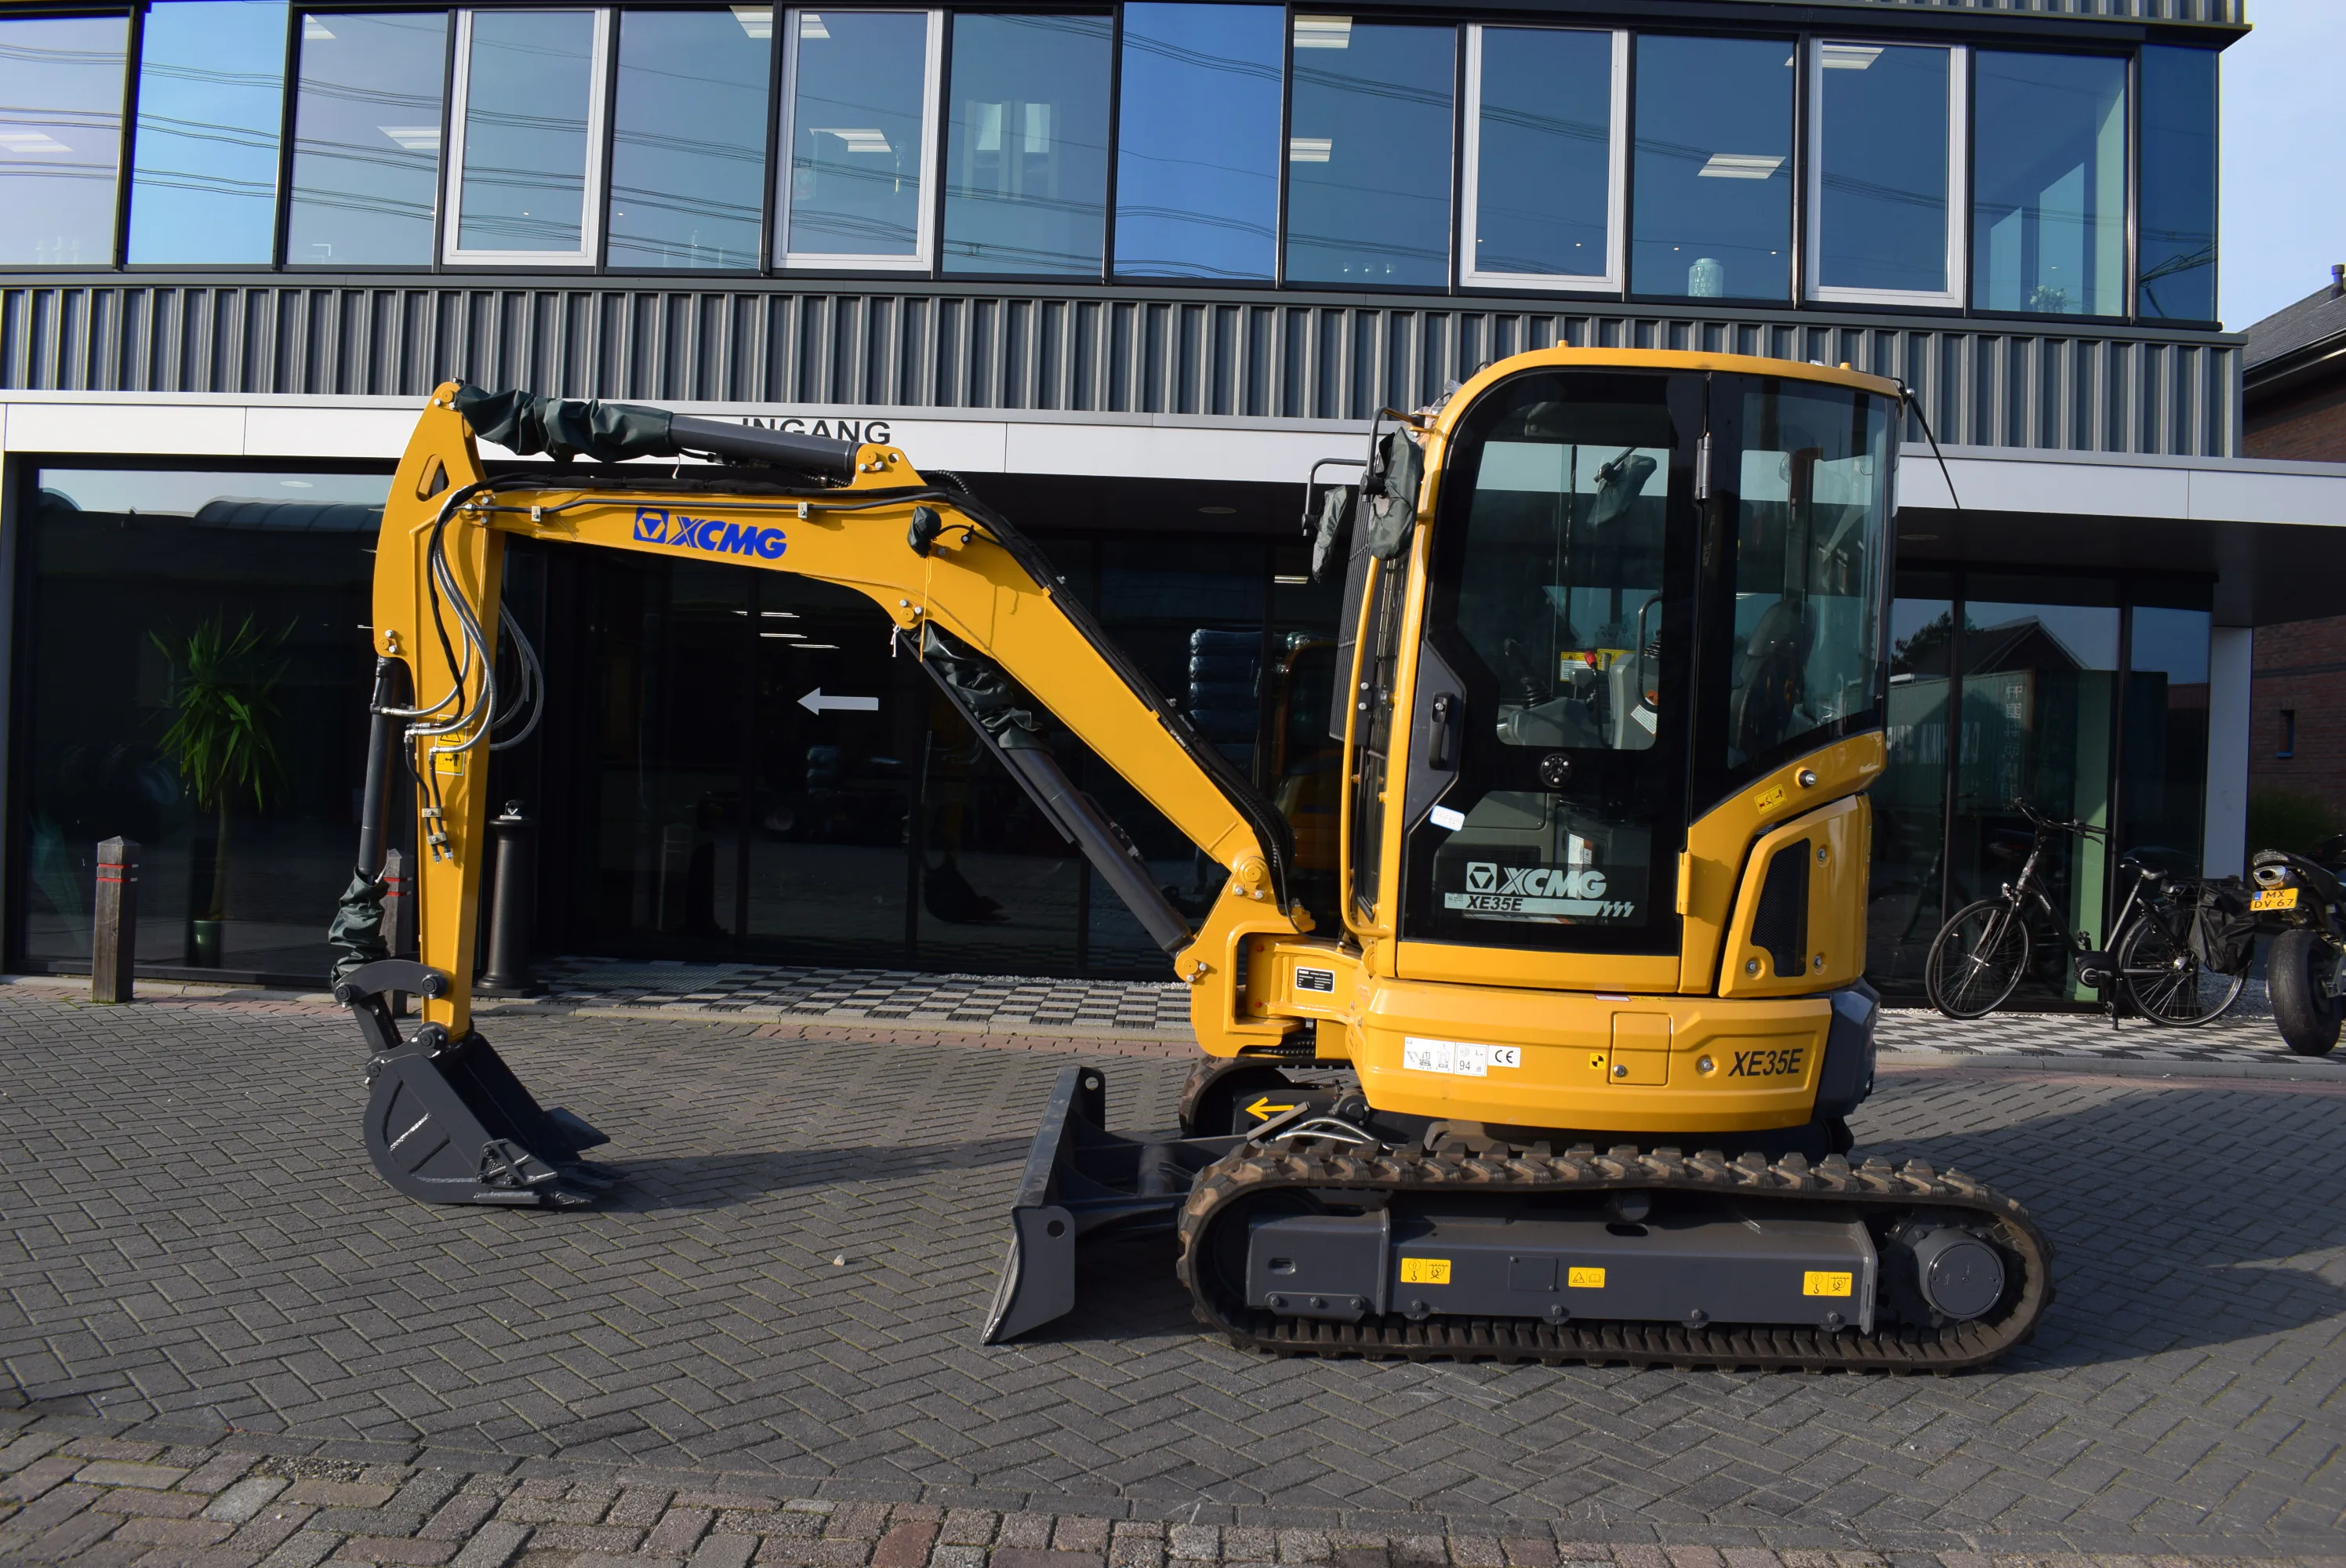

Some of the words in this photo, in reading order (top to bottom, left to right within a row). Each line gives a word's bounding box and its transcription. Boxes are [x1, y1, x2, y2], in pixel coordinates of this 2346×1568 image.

[666, 515, 787, 560] XCMG
[1496, 867, 1607, 900] XCMG
[1466, 895, 1523, 912] XE35E
[2254, 898, 2294, 909] DV-67
[2265, 891, 2286, 899] MX
[1459, 1060, 1471, 1071] 94
[1727, 1048, 1804, 1077] XE35E
